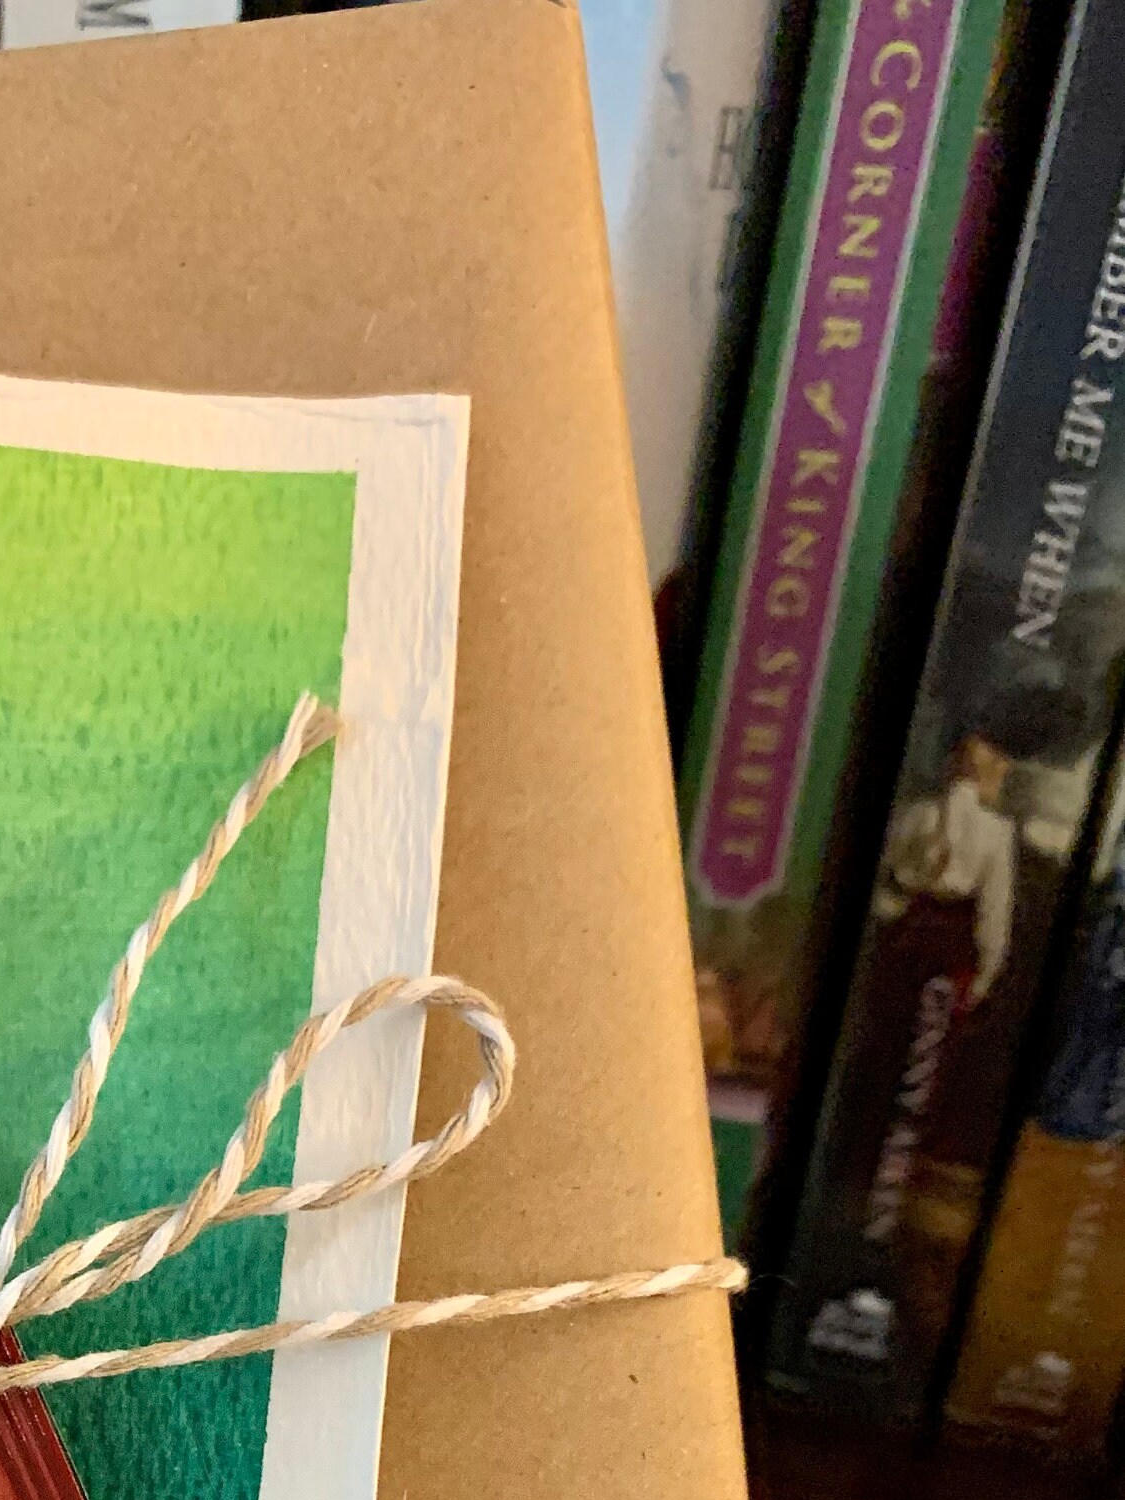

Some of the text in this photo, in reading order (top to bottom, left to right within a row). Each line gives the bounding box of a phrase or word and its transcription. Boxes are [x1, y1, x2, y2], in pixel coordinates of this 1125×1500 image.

[817, 40, 923, 352] CORNER
[765, 450, 840, 618] KING
[1012, 483, 1089, 648] WHEN
